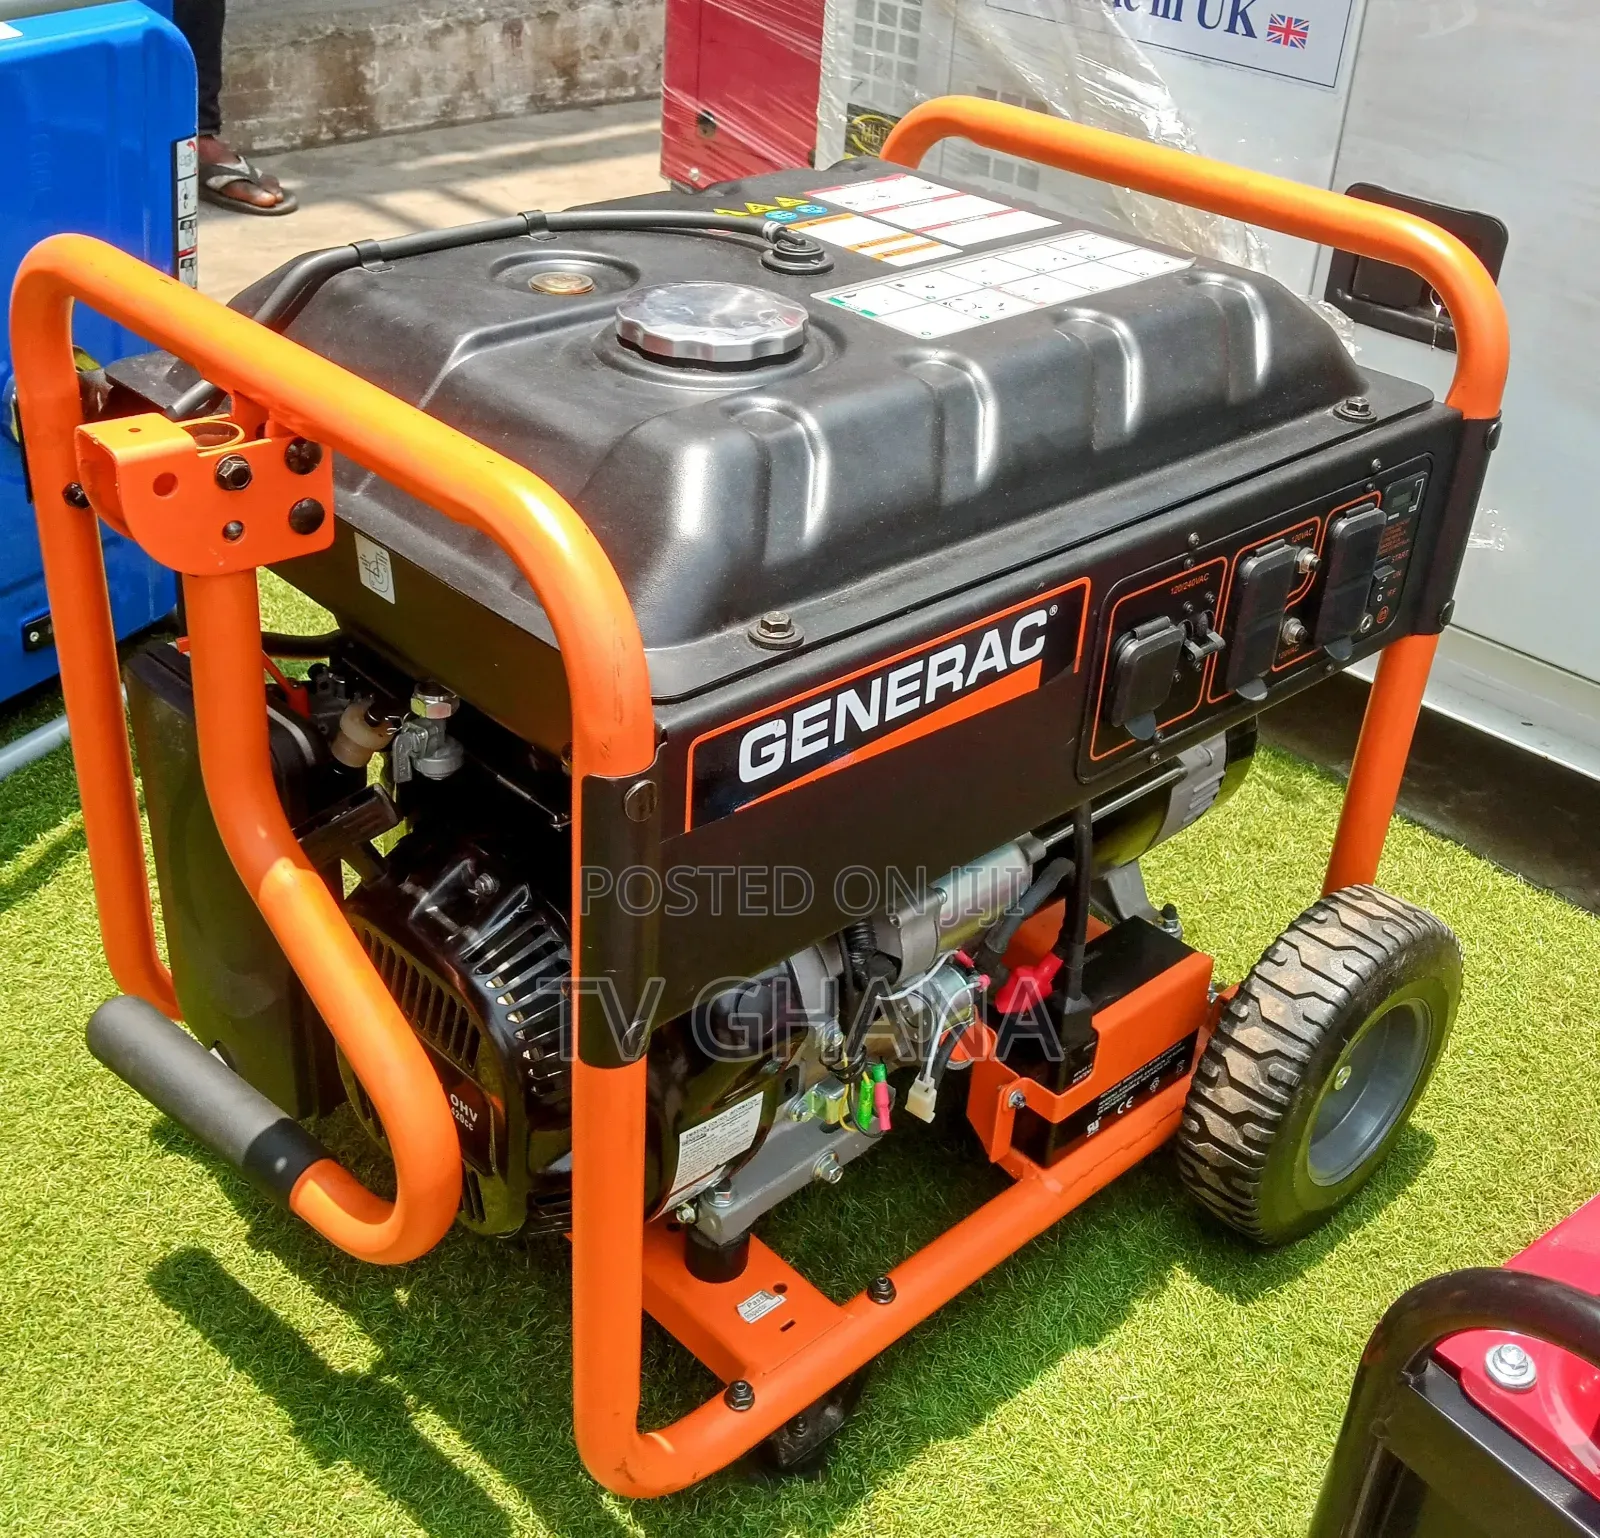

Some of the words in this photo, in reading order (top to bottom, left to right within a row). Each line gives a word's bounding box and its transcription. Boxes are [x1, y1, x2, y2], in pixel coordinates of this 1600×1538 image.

[1197, 0, 1258, 39] UK
[1170, 572, 1210, 595] 120/240VAC
[738, 608, 1047, 784] GENERAC
[450, 1093, 478, 1122] OHV
[746, 1294, 765, 1308] Pass
